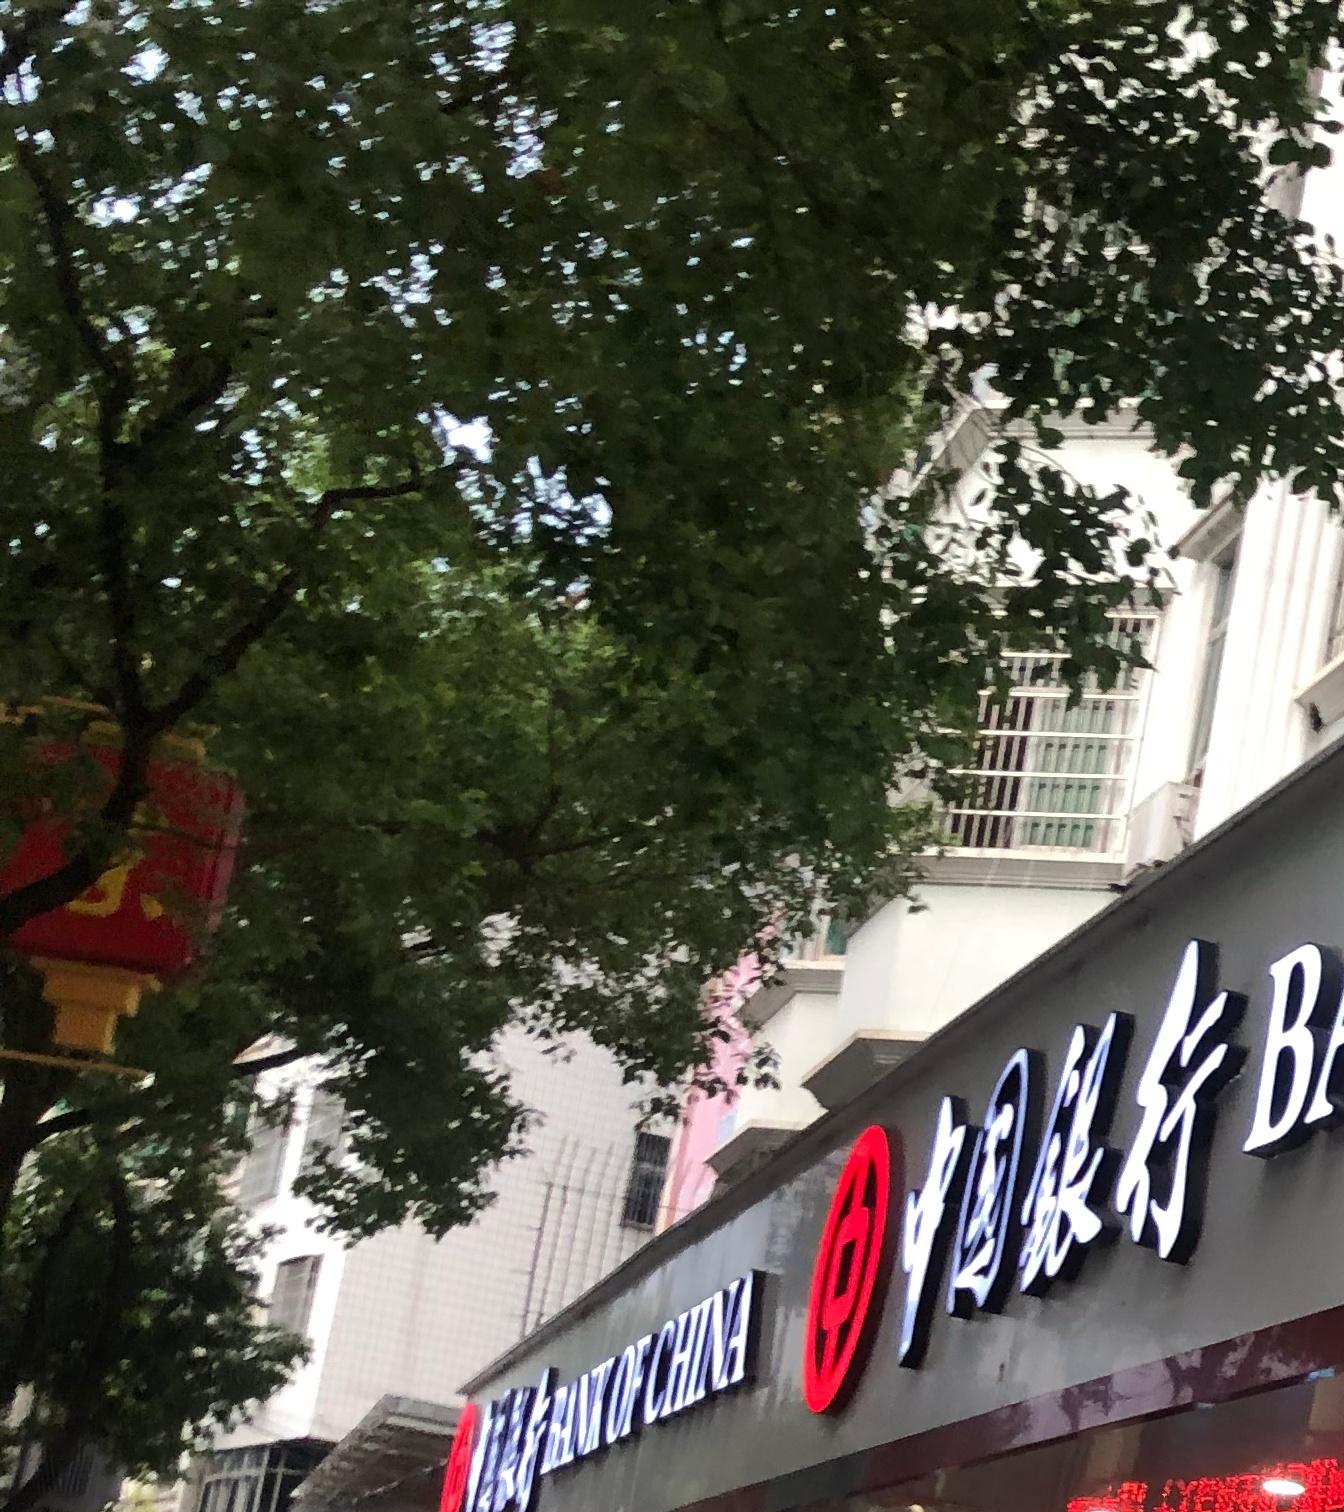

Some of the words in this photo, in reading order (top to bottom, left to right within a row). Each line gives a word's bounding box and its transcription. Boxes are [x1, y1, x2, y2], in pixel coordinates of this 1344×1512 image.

[899, 939, 1230, 1363] 中国银行
[540, 1356, 617, 1476] BANK
[644, 1269, 755, 1425] CHINA
